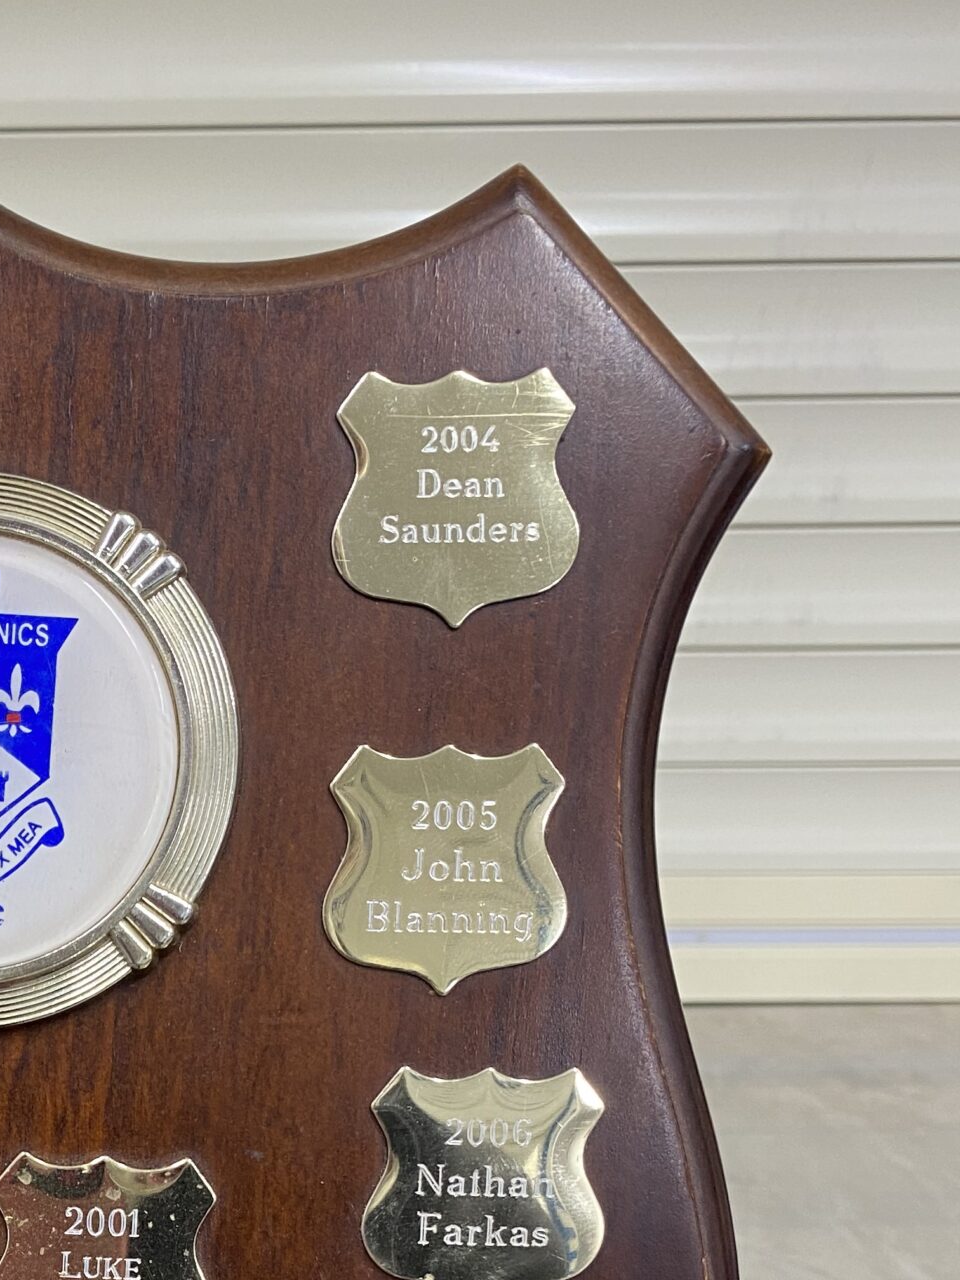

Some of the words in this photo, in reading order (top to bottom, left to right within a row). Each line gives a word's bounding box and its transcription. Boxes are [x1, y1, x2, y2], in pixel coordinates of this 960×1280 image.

[421, 424, 500, 453] 2004
[416, 468, 505, 498] Dean
[378, 513, 540, 544] Saunders
[411, 800, 497, 830] 2005
[7, 821, 43, 856] MEA
[401, 848, 503, 882] John
[366, 900, 533, 942] Blanning
[444, 1118, 533, 1147] 2006
[415, 1163, 555, 1198] Nathan
[64, 1206, 140, 1238] 2001
[416, 1211, 549, 1247] Farkas
[59, 1251, 141, 1280] LUKE
